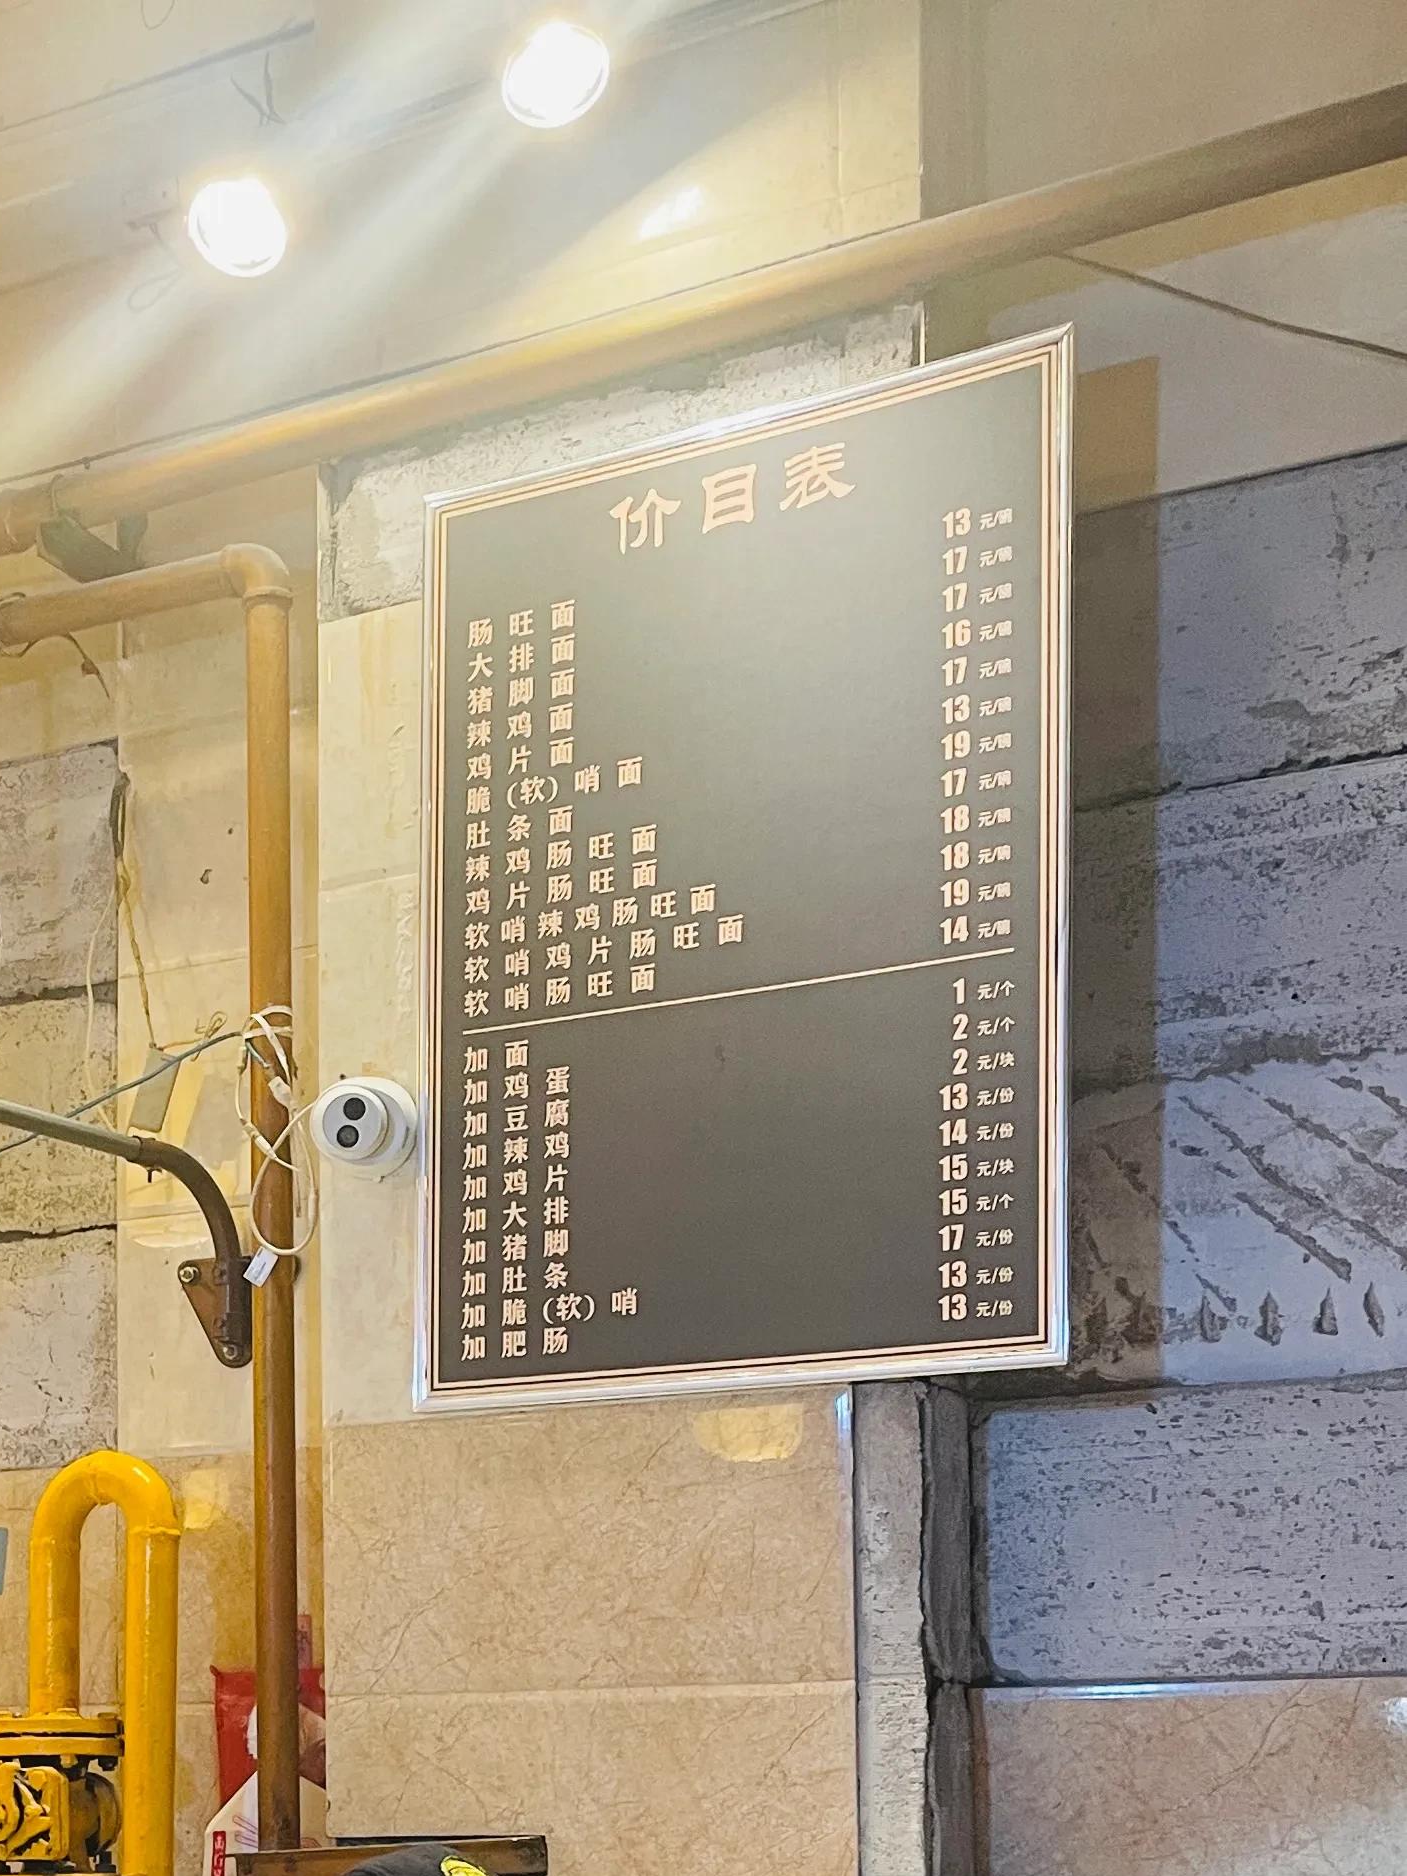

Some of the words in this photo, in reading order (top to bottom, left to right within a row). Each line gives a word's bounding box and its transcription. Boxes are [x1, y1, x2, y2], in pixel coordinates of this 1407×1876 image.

[610, 443, 855, 554] 价目表
[943, 509, 970, 538] 13
[943, 546, 967, 575] 17
[943, 583, 967, 612] 17
[468, 600, 575, 648] 肠旺面
[942, 620, 970, 649] 16
[468, 633, 575, 682] 大排面
[942, 657, 967, 686] 17
[468, 668, 574, 715] 猪脚面
[942, 695, 969, 724] 13
[467, 702, 573, 749] 辣鸡面
[467, 737, 574, 781] 鸡片面
[941, 731, 970, 760] 19
[941, 768, 966, 797] 17
[466, 805, 573, 850] 肚条面
[941, 805, 969, 833] 18
[466, 824, 656, 884] 辣鸡肠旺面
[941, 842, 969, 870] 18
[465, 859, 657, 915] 鸡片肠旺面
[940, 879, 969, 907] 19
[465, 884, 715, 950] 软哨辣鸡肠旺面
[940, 916, 969, 944] 14
[465, 914, 743, 983] 软哨鸡片肠旺面
[464, 963, 655, 1017] 软哨肠旺面
[953, 978, 964, 1004] 1
[978, 981, 1015, 1000] 元/个
[953, 1014, 968, 1040] 2
[977, 1017, 1015, 1036] 元/个
[464, 1040, 528, 1074] 加面
[953, 1048, 968, 1075] 2
[977, 1052, 1014, 1071] 元/块
[463, 1066, 570, 1106] 加鸡蛋
[939, 1083, 967, 1110] 13
[977, 1087, 1014, 1106] 元/份
[463, 1099, 570, 1138] 加豆腐
[939, 1119, 967, 1146] 14
[977, 1123, 1014, 1141] 元/份
[462, 1131, 569, 1170] 加辣鸡
[939, 1154, 967, 1181] 15
[976, 1158, 1014, 1177] 元/块
[462, 1164, 568, 1201] 加鸡片
[462, 1196, 569, 1233] 加大排
[939, 1188, 967, 1215] 15
[976, 1194, 1014, 1211] 元/个
[462, 1229, 568, 1265] 加猪脚
[939, 1224, 963, 1251] 17
[976, 1229, 1013, 1247] 元/份
[462, 1262, 568, 1297] 加肚条
[938, 1261, 967, 1288] 13
[976, 1267, 1013, 1284] 元/份
[938, 1294, 967, 1320] 13
[976, 1300, 1013, 1317] 元/份
[462, 1327, 568, 1360] 加肥肠
